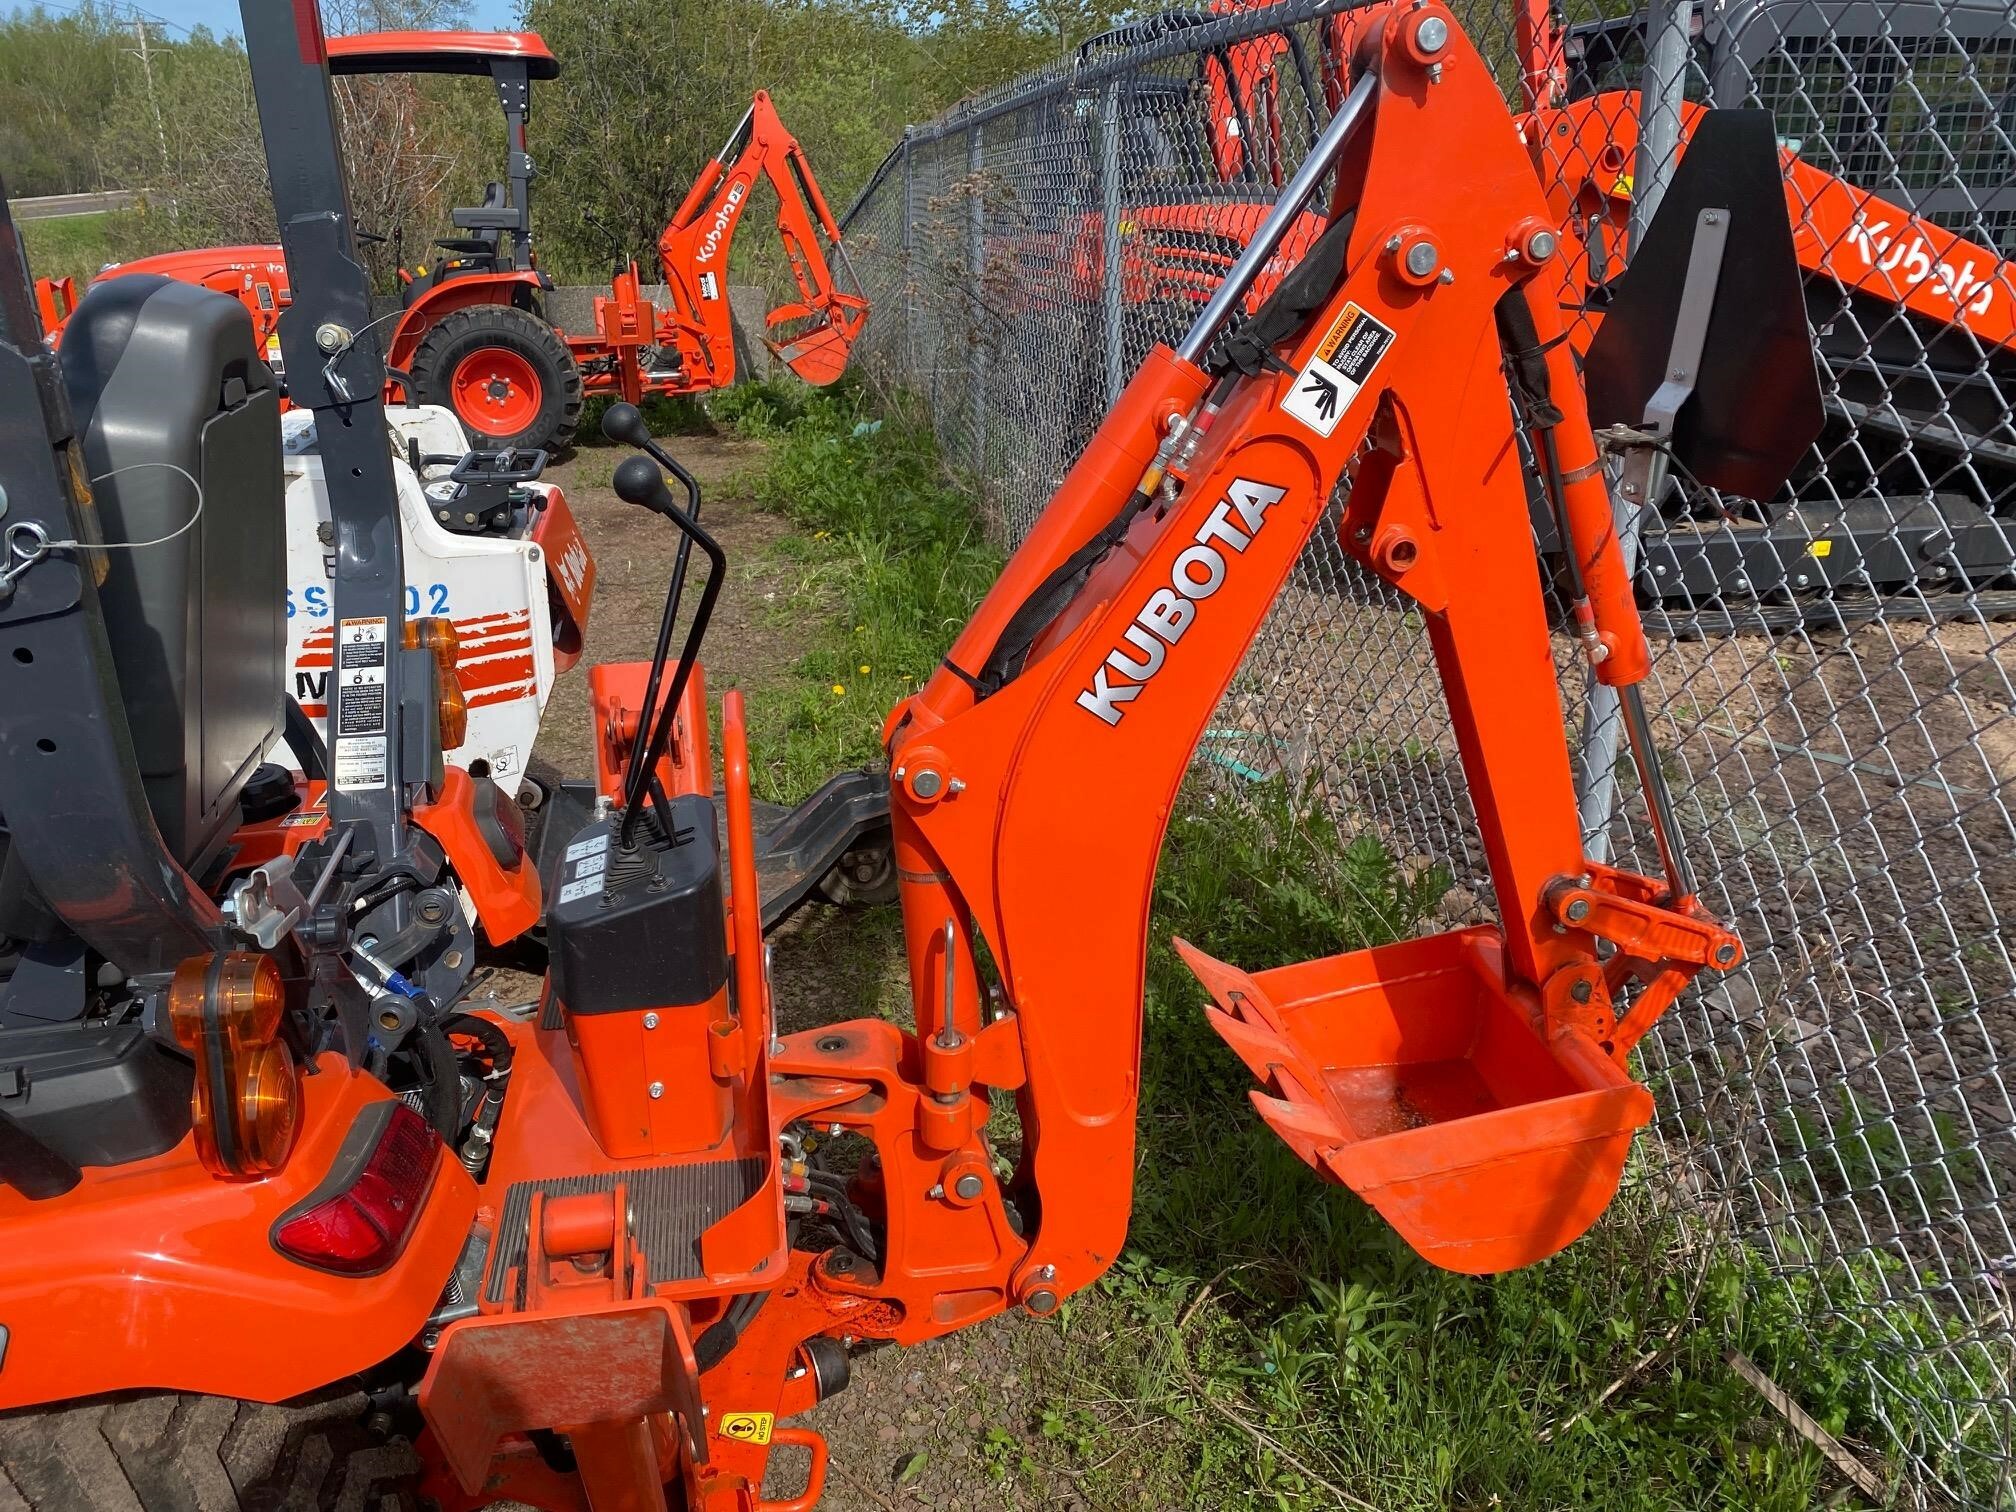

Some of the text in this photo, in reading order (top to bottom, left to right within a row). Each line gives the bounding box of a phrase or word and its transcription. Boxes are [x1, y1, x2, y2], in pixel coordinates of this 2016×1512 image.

[696, 203, 735, 263] Kubota
[1847, 212, 1994, 315] Kubota
[1327, 310, 1355, 349] WARNING
[1332, 316, 1368, 367] TO AVOID PERSONAL
[1342, 331, 1370, 370] STAY CLEAR OF
[1346, 329, 1377, 373] OPERATING AREA
[1350, 367, 1357, 376] OF
[1355, 357, 1364, 368] THE
[1074, 476, 1289, 726] KUBOTA
[351, 618, 383, 626] WARNING
[758, 1431, 765, 1440] NO
